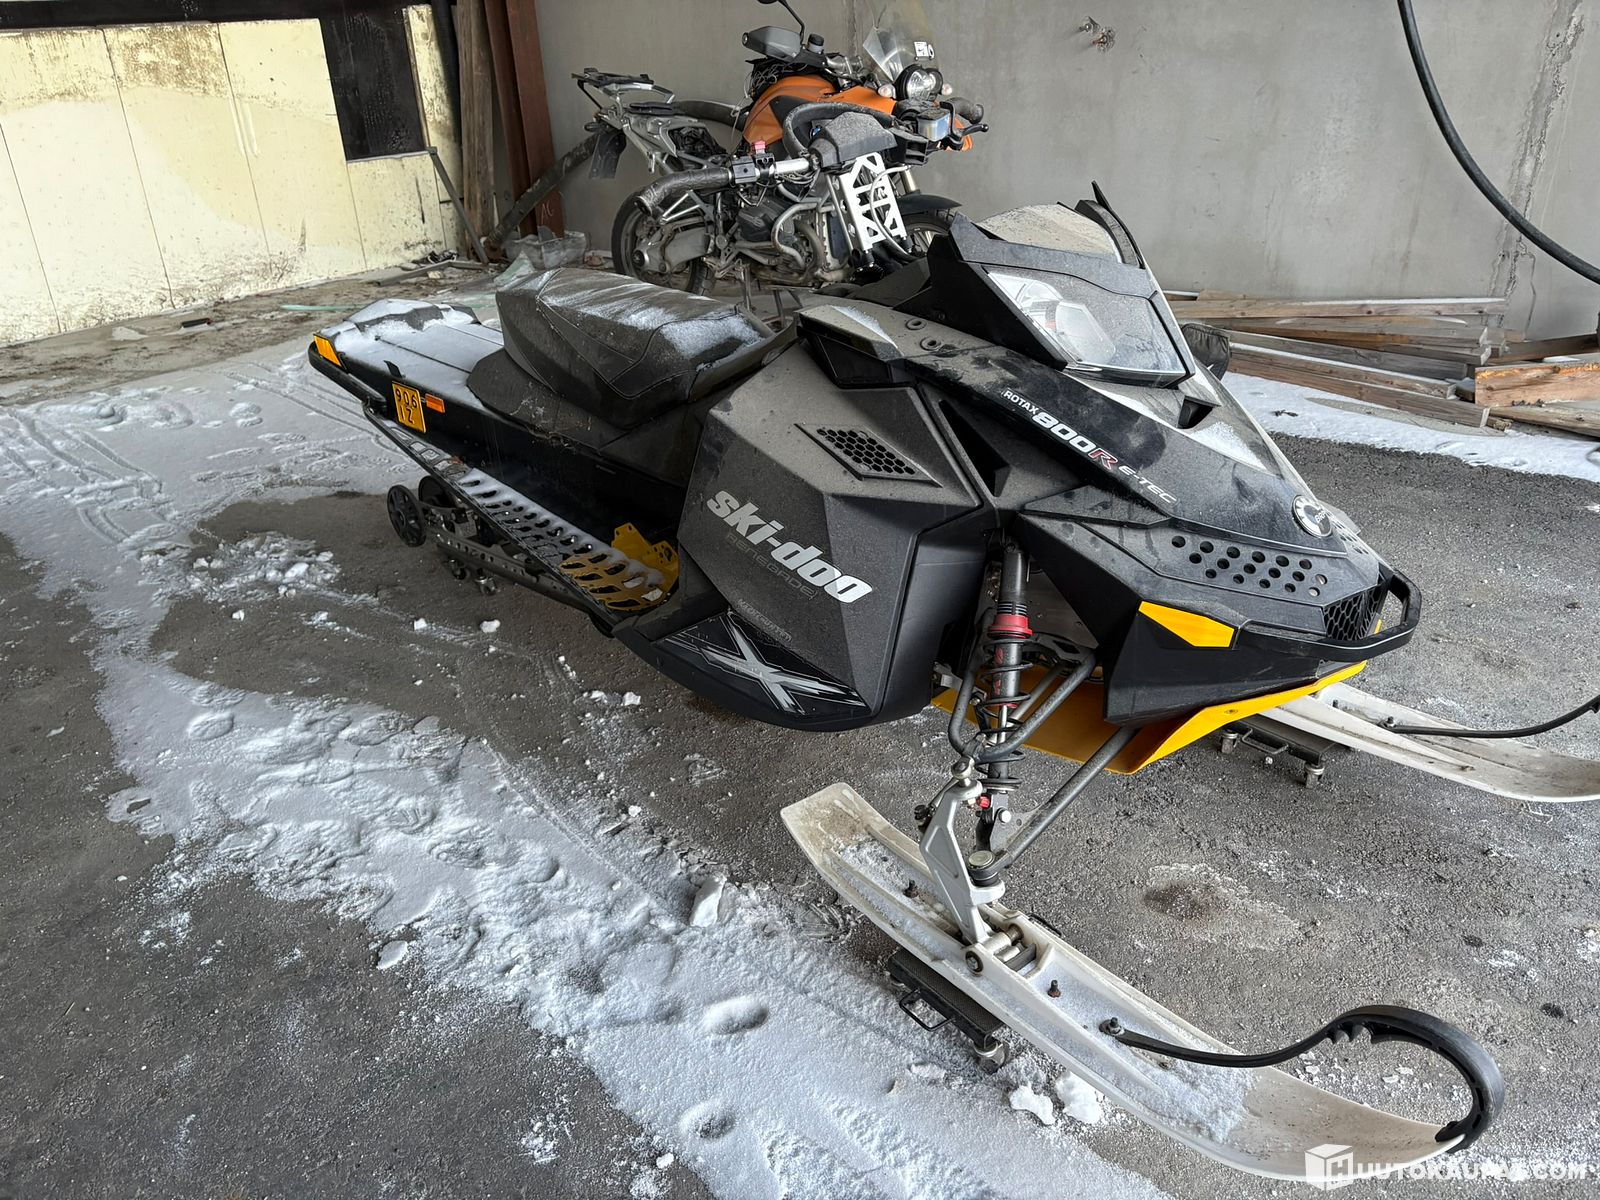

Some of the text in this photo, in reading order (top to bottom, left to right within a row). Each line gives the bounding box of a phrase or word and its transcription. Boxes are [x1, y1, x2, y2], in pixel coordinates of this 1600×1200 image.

[395, 388, 418, 409] 906
[1003, 390, 1178, 504] ROTAX 800R E-TEC
[706, 490, 873, 604] ski-doo
[727, 532, 816, 599] RENEGADE
